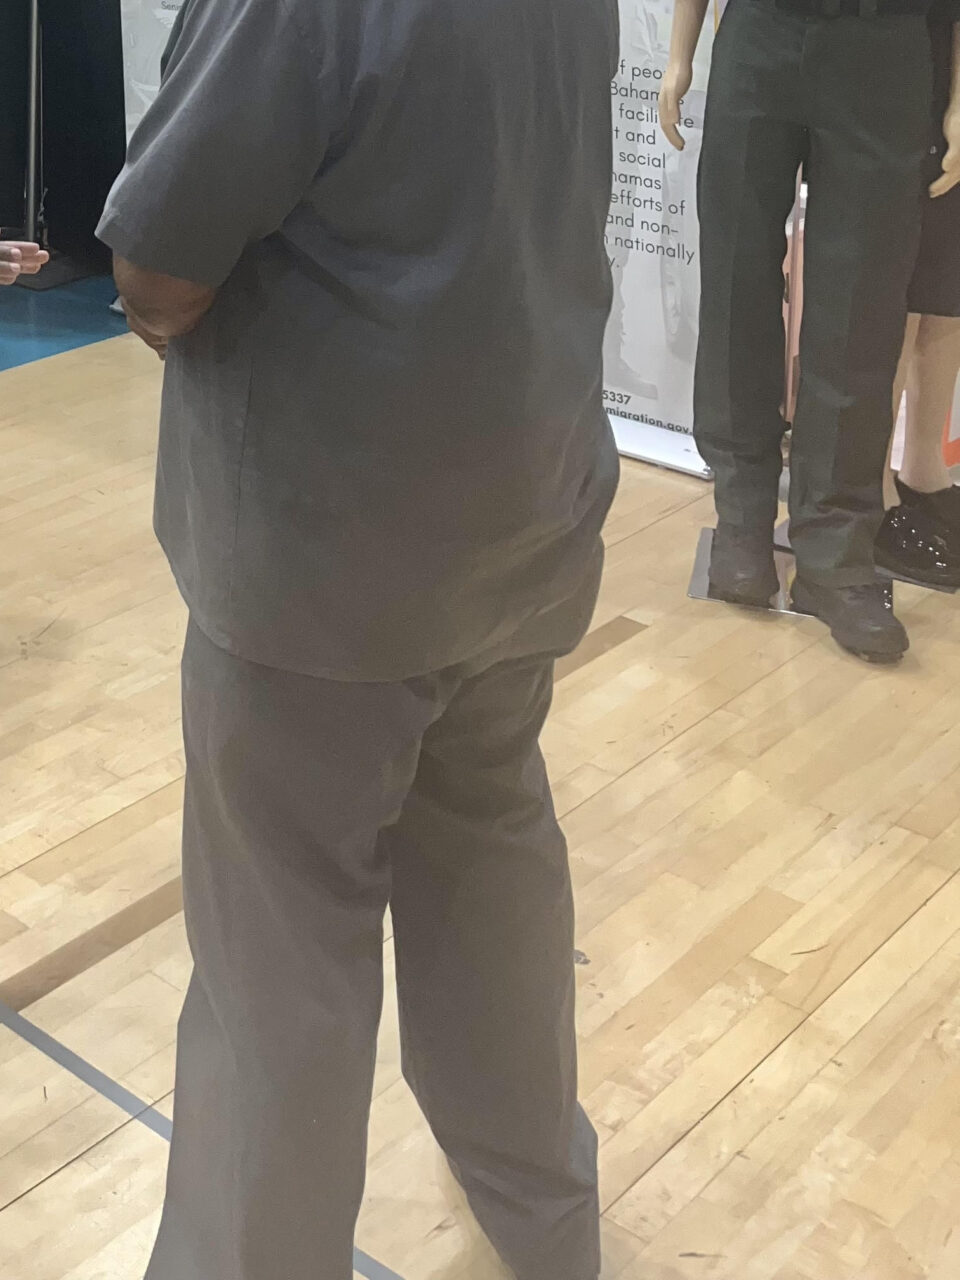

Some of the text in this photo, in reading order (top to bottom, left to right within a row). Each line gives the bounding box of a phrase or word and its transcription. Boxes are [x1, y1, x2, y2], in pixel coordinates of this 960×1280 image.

[631, 66, 666, 81] peo
[625, 129, 656, 145] and
[619, 151, 666, 169] social
[610, 189, 686, 216] efforts of
[606, 212, 679, 235] and non-
[614, 236, 695, 265] nationally
